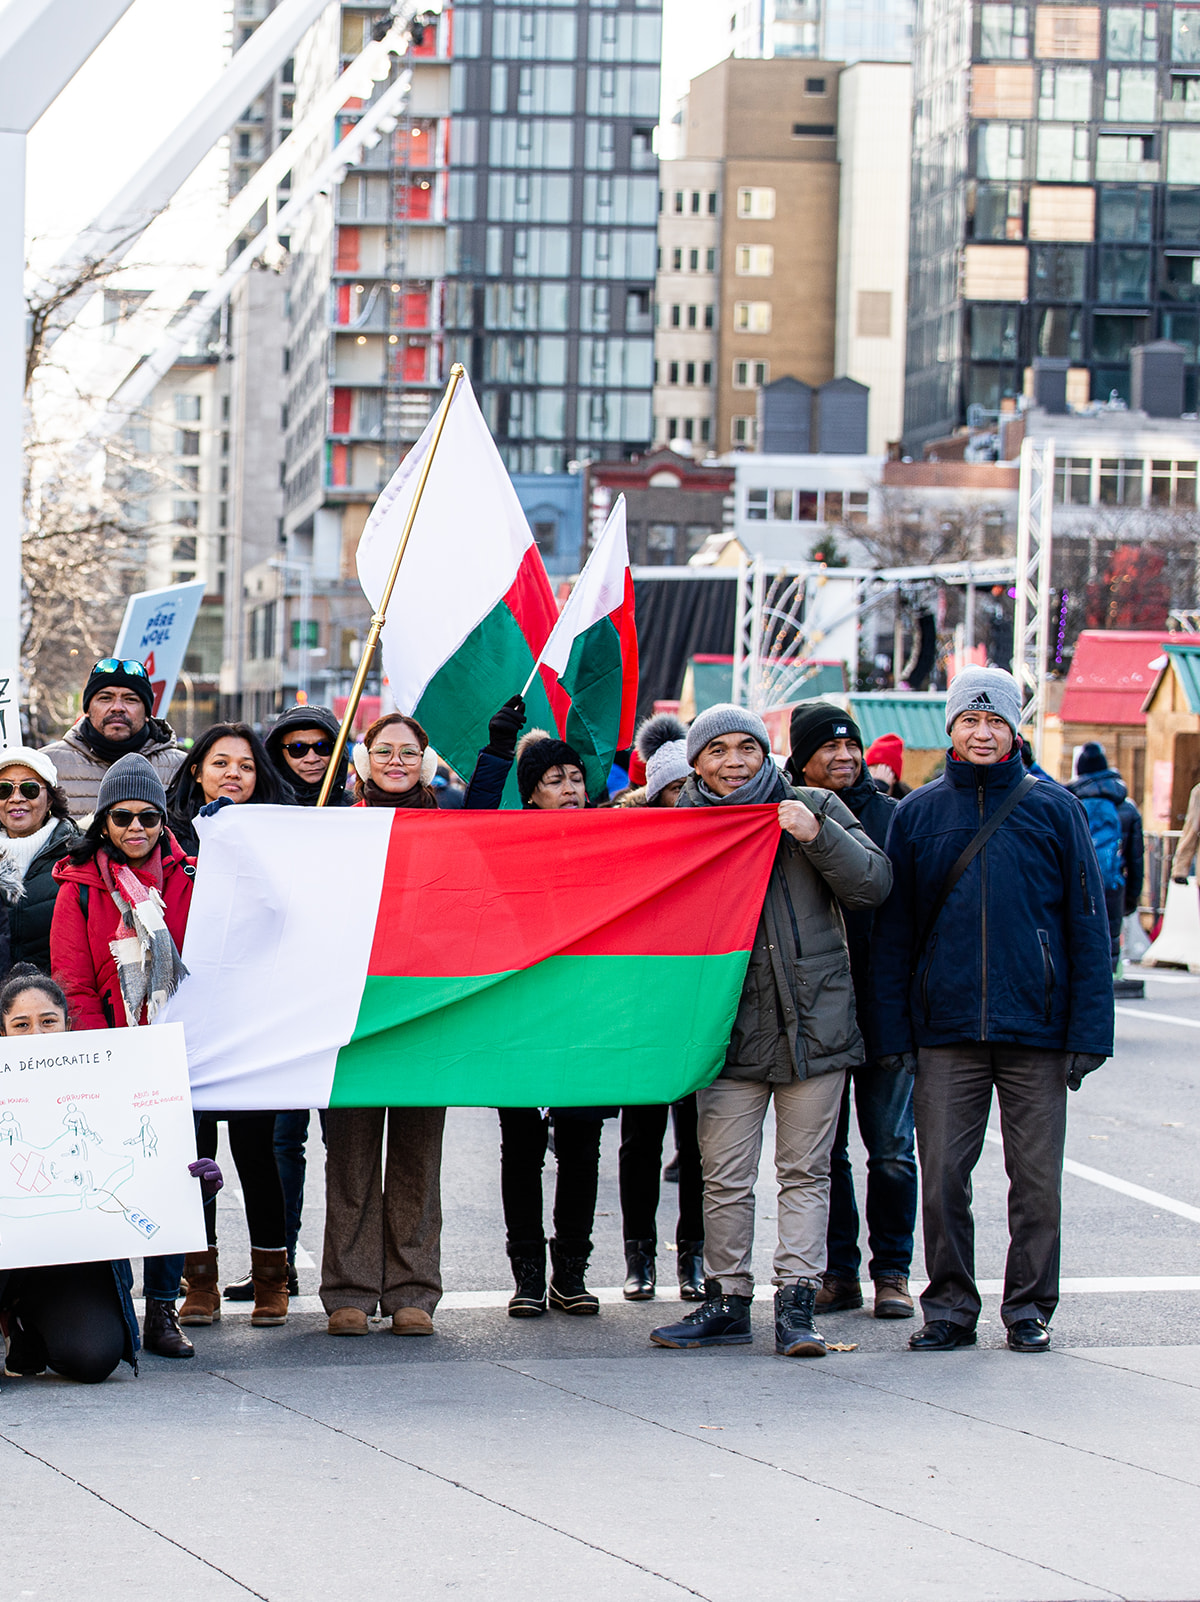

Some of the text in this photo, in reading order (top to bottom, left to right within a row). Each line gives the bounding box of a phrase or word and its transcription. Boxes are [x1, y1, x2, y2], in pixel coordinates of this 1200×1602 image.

[968, 703, 995, 711] adidas
[19, 1053, 100, 1072] DÉMOCRATIE
[57, 1093, 100, 1104] CORRUPTION
